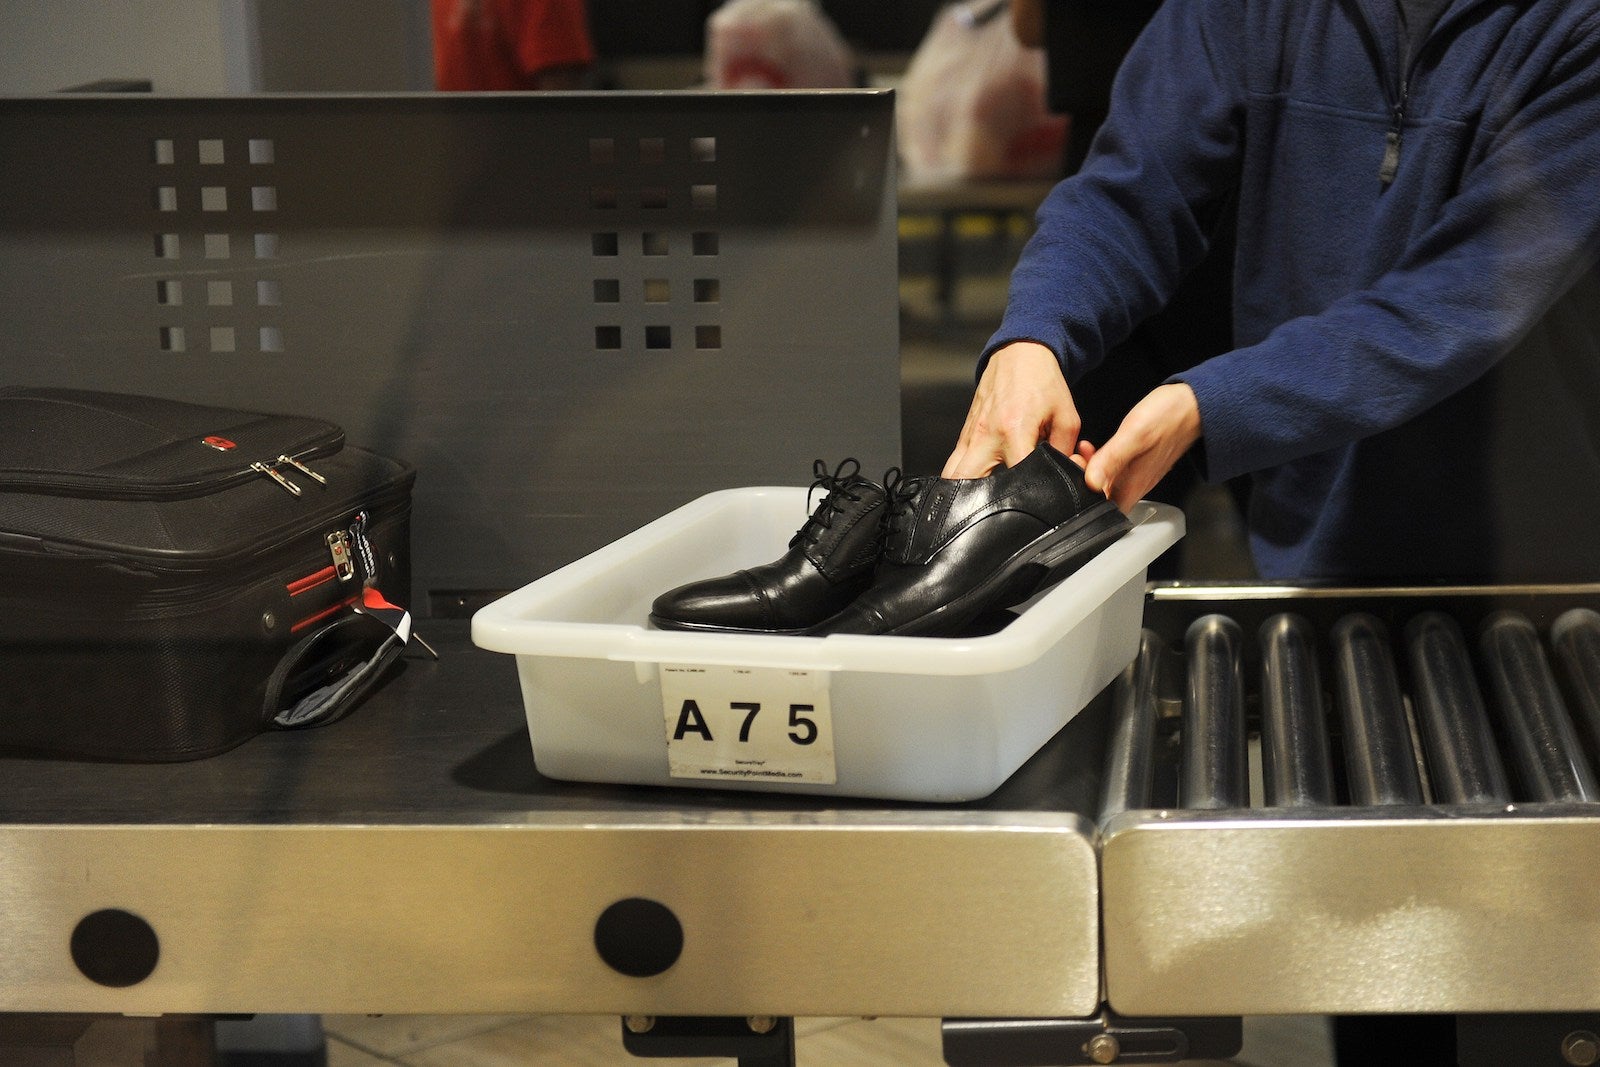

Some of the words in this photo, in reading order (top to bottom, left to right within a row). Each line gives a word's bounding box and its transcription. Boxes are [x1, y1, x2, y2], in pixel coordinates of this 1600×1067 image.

[673, 699, 714, 741] A
[730, 702, 761, 742] 7
[788, 704, 818, 746] 5
[700, 768, 803, 778] www.SecurityPointMedia.com
